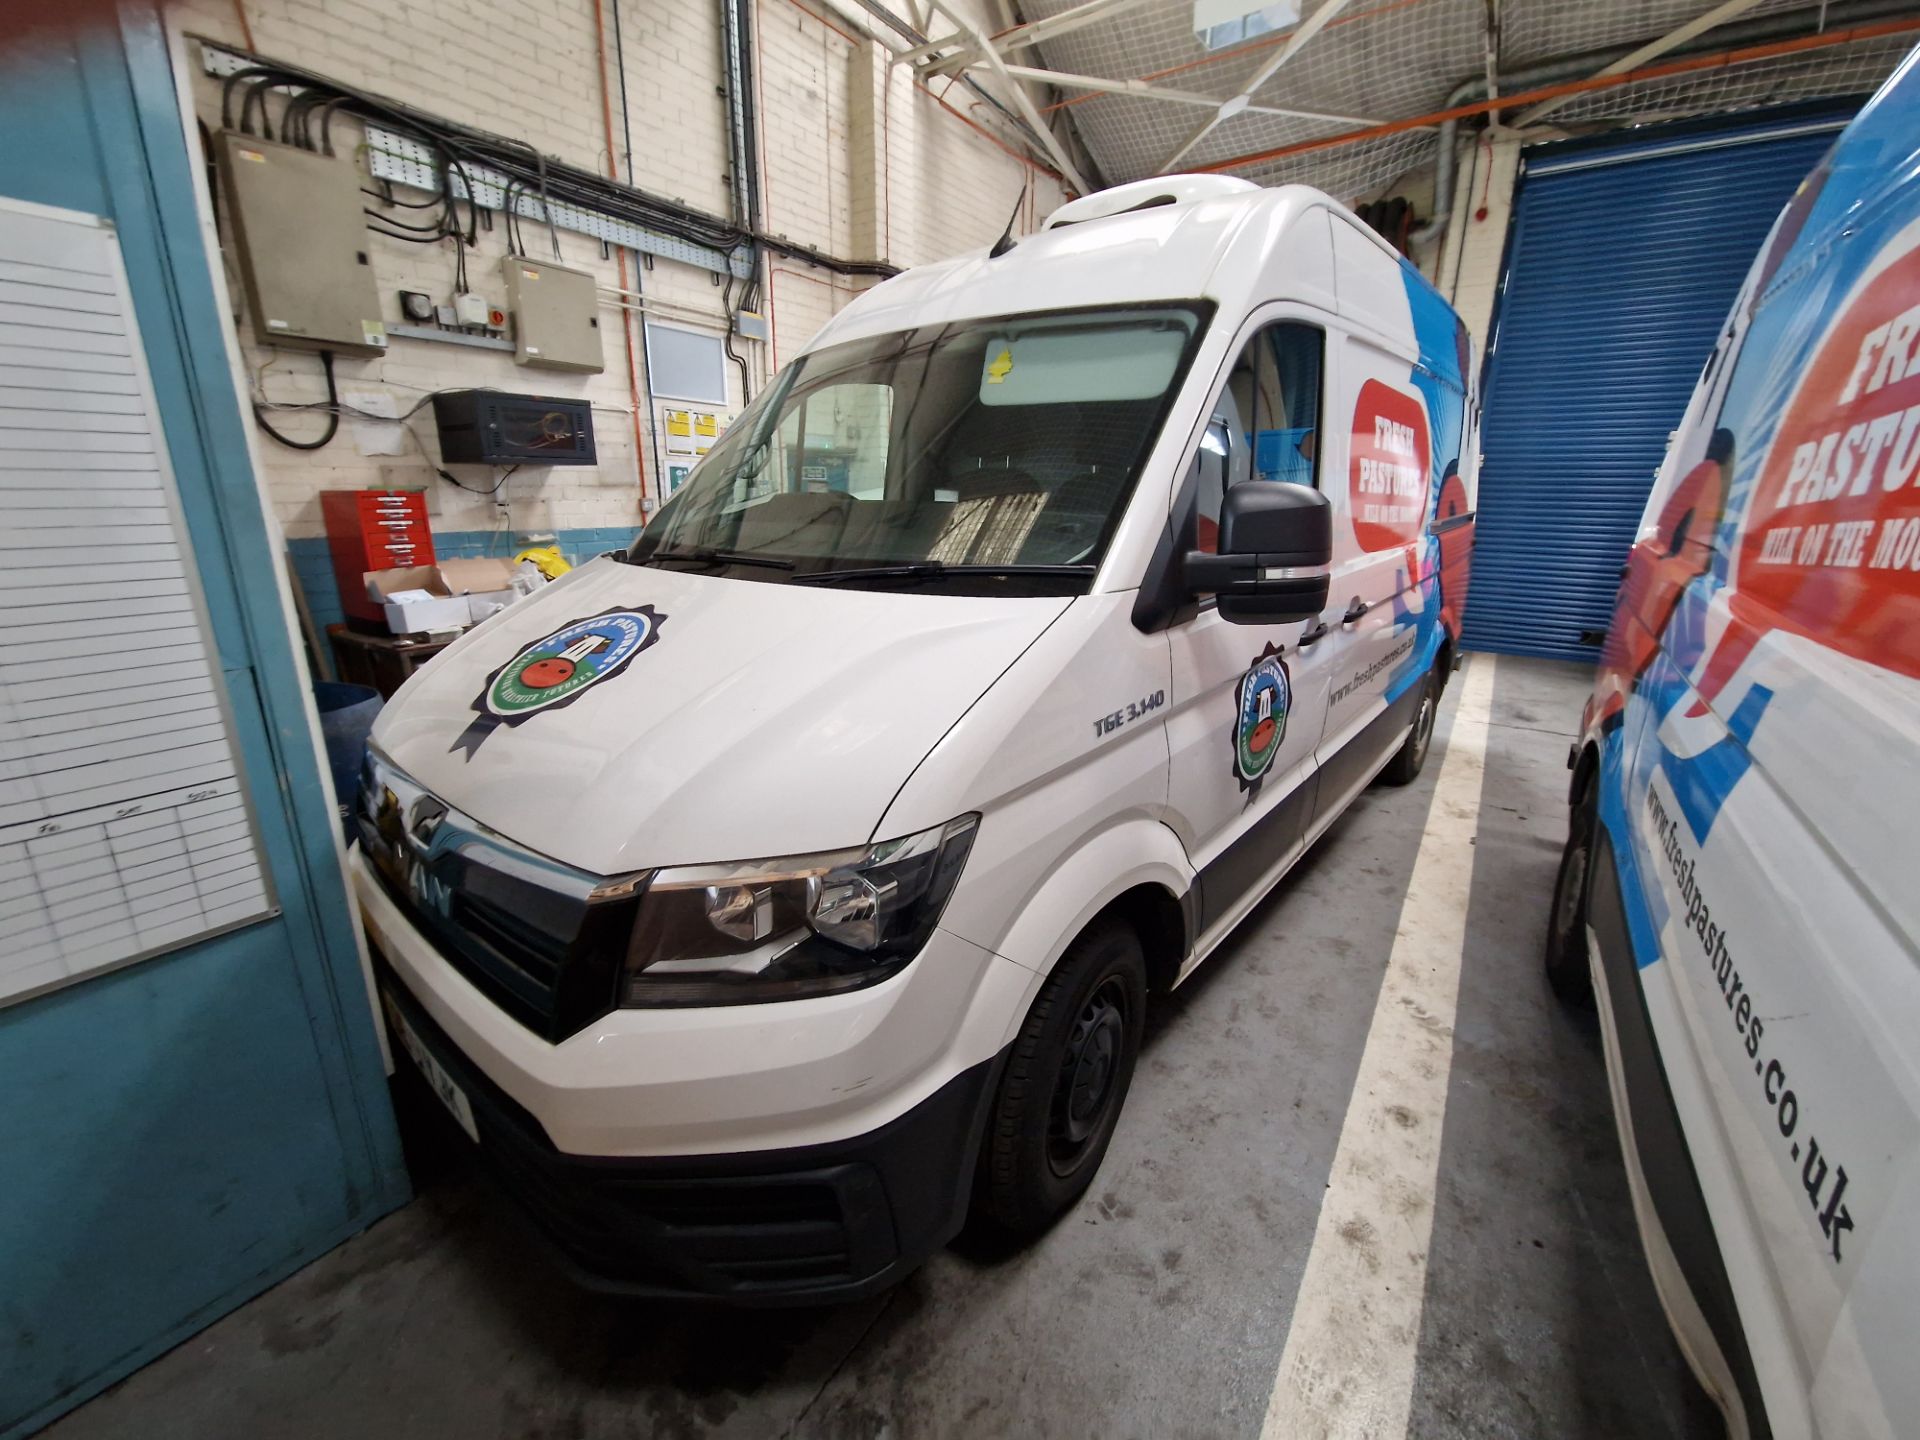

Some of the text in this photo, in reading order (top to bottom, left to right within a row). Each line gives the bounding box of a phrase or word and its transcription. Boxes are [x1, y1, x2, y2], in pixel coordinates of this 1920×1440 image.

[1374, 415, 1414, 457] FRESH
[1776, 405, 1920, 508] PASTU
[1359, 457, 1420, 497] PASTURES
[1758, 526, 1802, 565] MILK
[1798, 523, 1830, 565] ON
[1824, 520, 1876, 567] THE
[546, 616, 639, 663] FRESH PASTURES
[1093, 689, 1165, 738] TGE 3.140
[1242, 673, 1258, 722] FRESH
[1648, 783, 1854, 1263] www.freshpastures.co.uk
